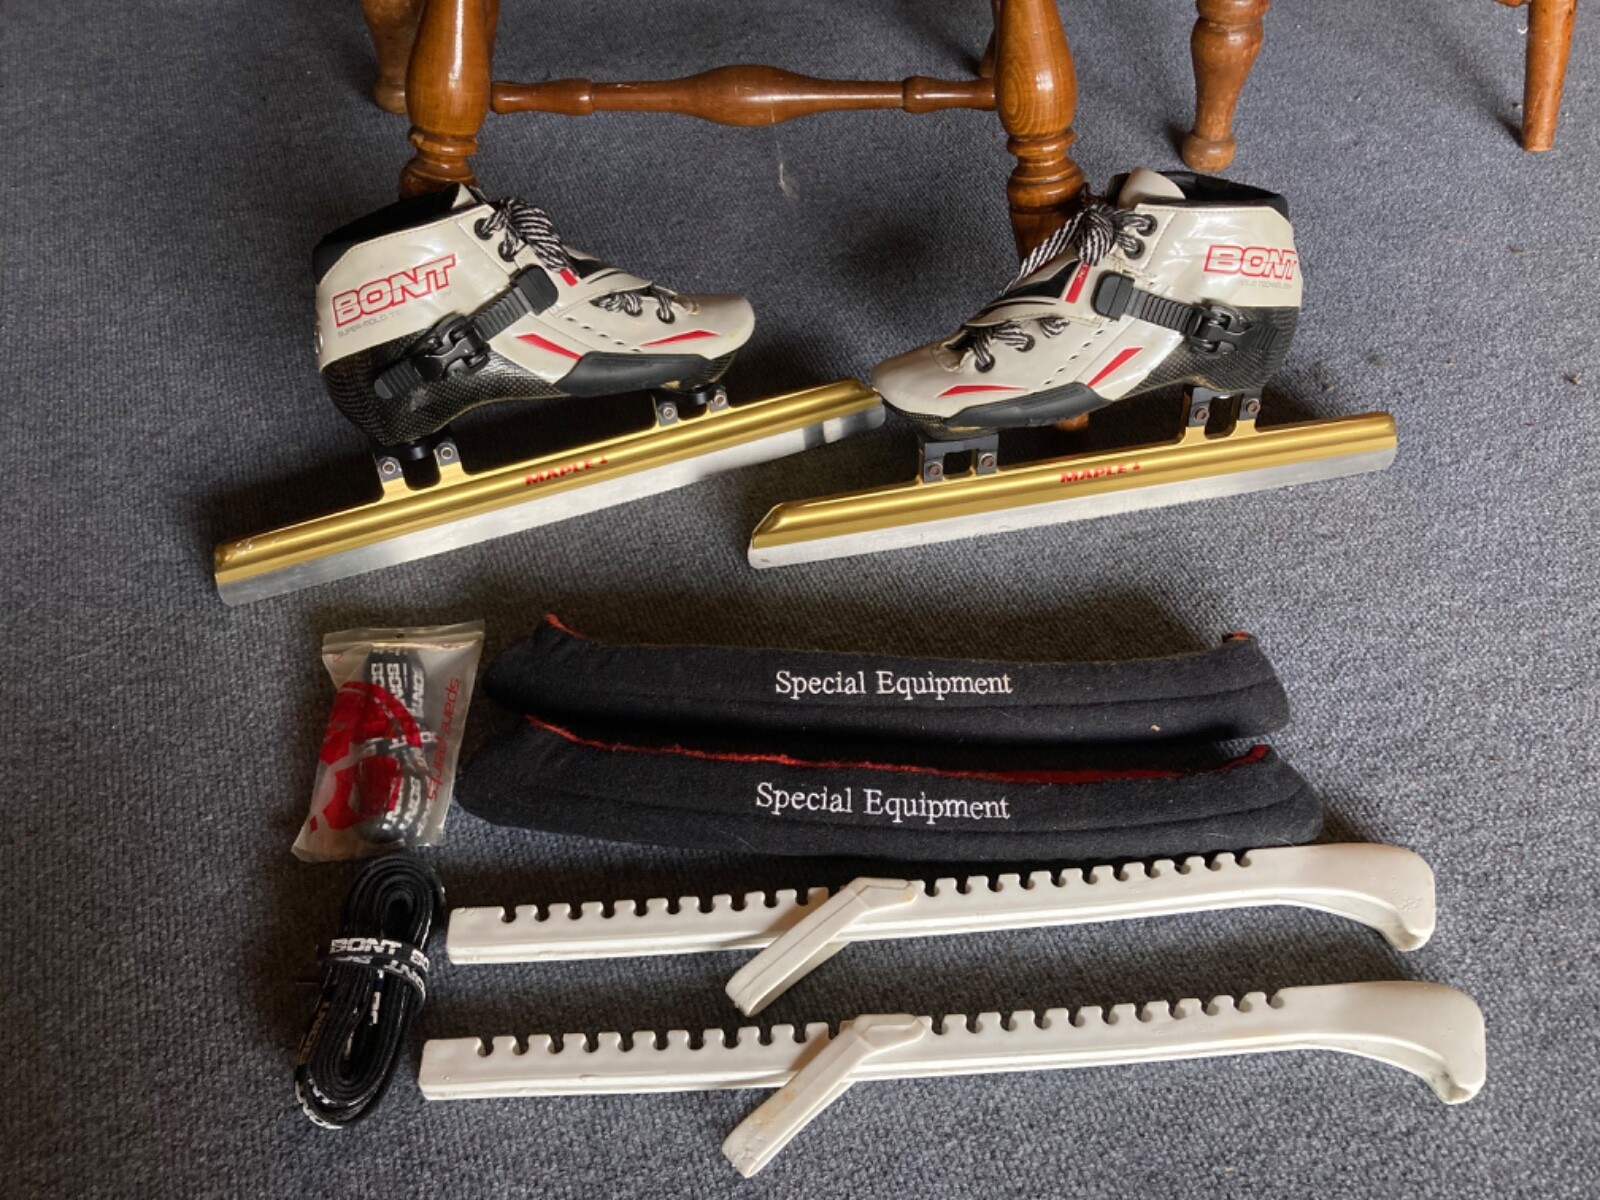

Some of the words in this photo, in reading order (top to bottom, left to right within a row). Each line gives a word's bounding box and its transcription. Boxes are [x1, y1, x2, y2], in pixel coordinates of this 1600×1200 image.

[1203, 243, 1297, 280] BONT
[332, 253, 456, 328] BONT
[525, 459, 594, 486] MAPLE
[1060, 463, 1127, 483] MAPLE
[775, 669, 867, 700] Special
[875, 670, 1014, 701] Equipment
[756, 781, 853, 816] Special
[863, 788, 1011, 825] Equipment
